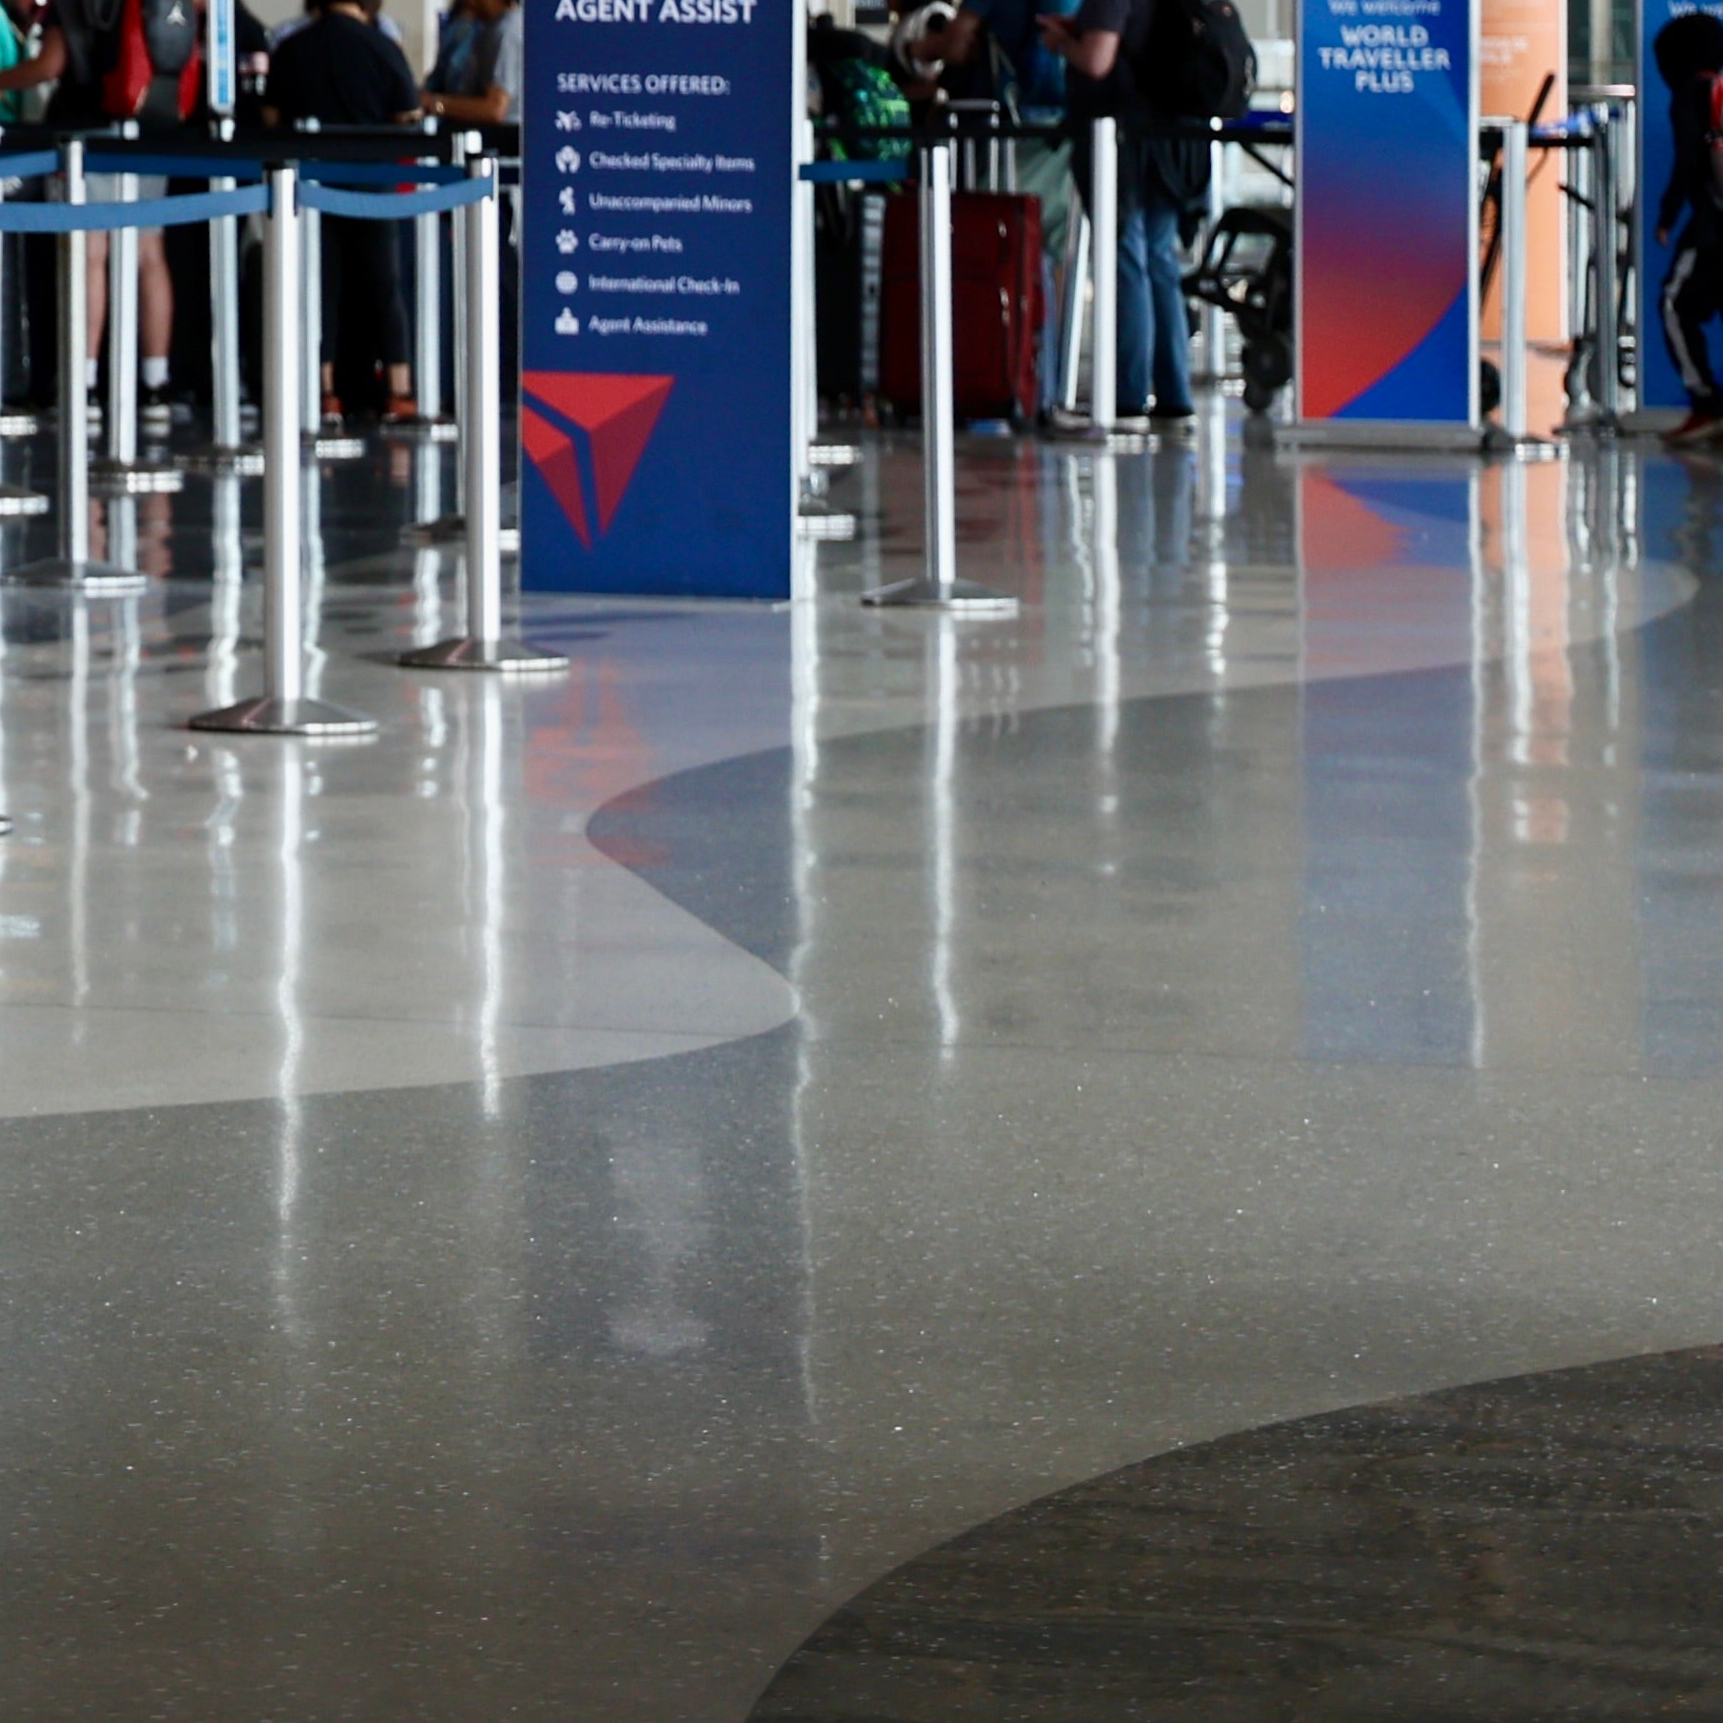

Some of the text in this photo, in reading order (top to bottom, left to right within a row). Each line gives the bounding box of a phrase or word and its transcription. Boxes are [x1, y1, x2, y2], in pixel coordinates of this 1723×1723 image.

[1340, 25, 1429, 48] WORLD
[1318, 47, 1450, 71] TRAVELLER
[557, 73, 729, 95] SERVICES OFFERED:
[1355, 70, 1415, 93] PLUS
[589, 151, 755, 172] Checked Specialty Items
[589, 193, 752, 212] Unaccompanied Minors
[649, 235, 683, 252] Pets
[589, 275, 674, 293] International
[589, 315, 708, 337] Agent Assistance
